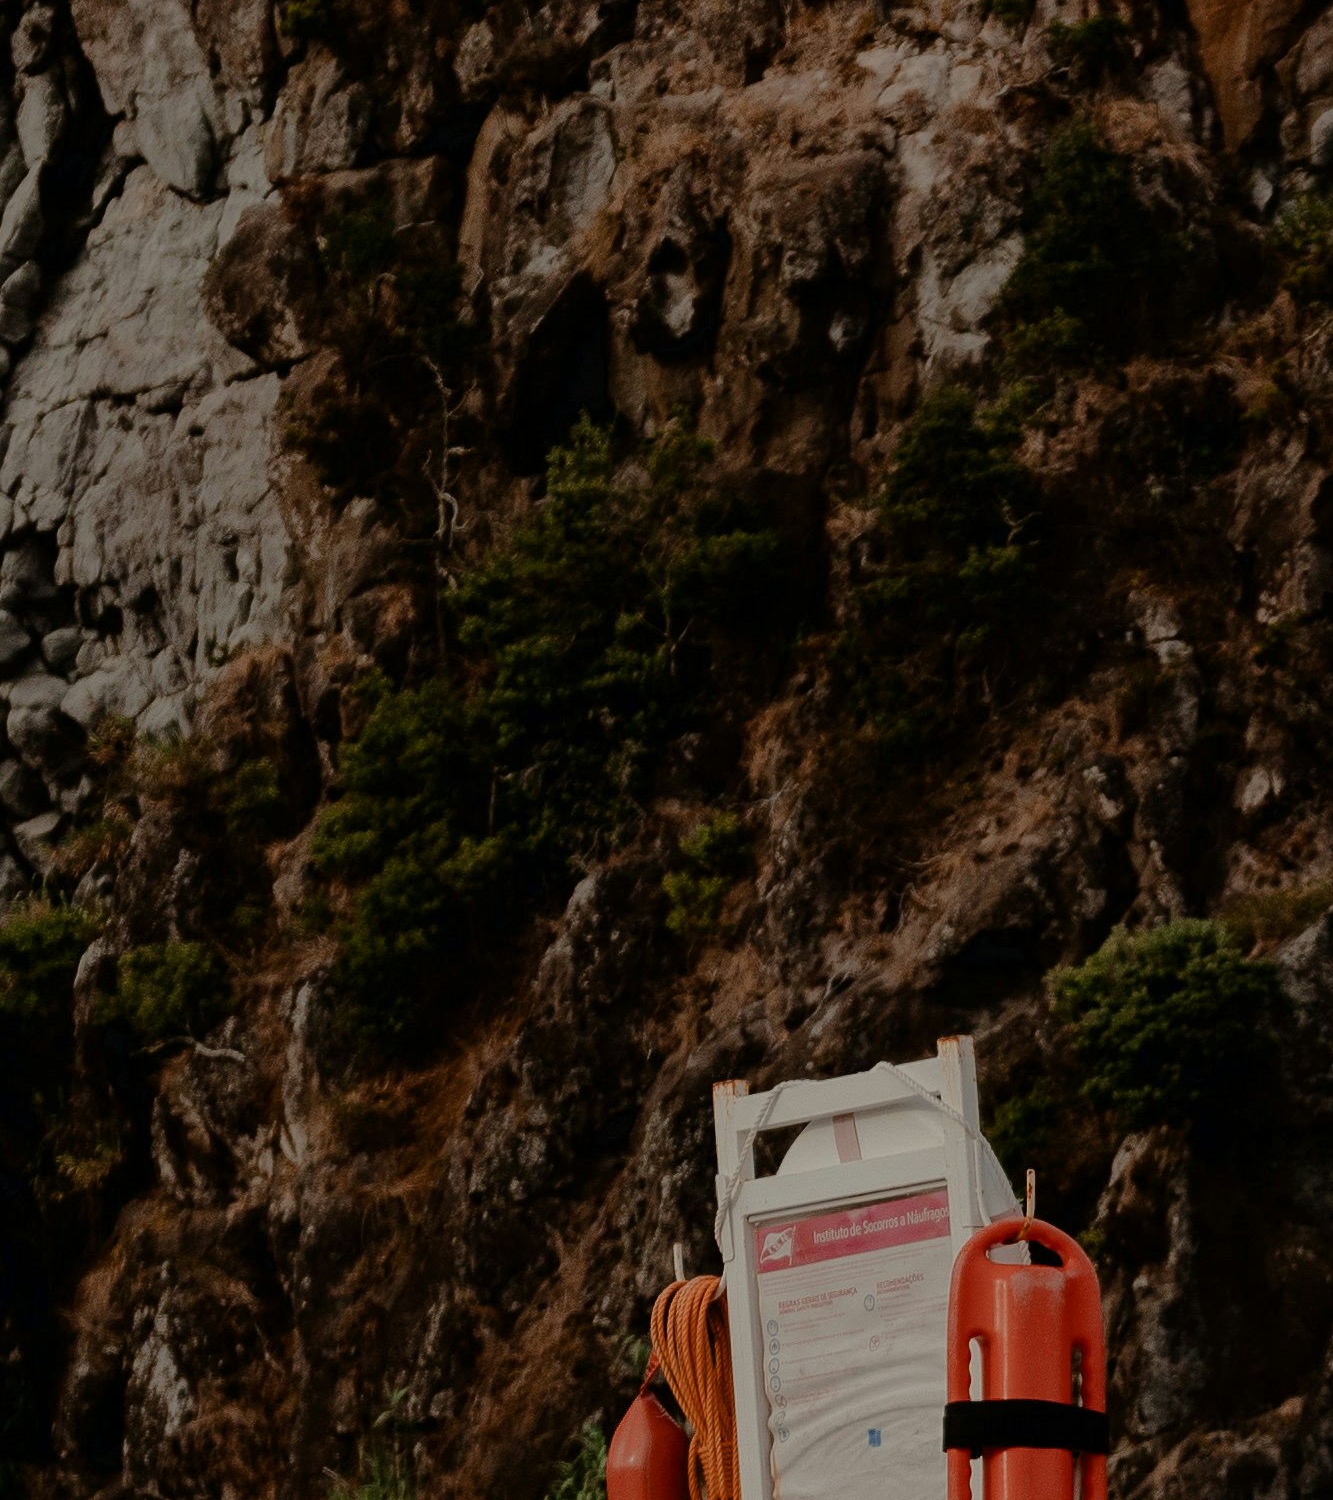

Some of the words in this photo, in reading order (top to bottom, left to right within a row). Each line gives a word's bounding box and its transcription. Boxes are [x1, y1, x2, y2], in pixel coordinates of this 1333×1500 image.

[813, 1227, 849, 1244] Instituto
[850, 1223, 862, 1236] de
[863, 1217, 899, 1234] Socorros
[900, 1217, 906, 1226] a
[906, 1206, 950, 1225] Náufragos
